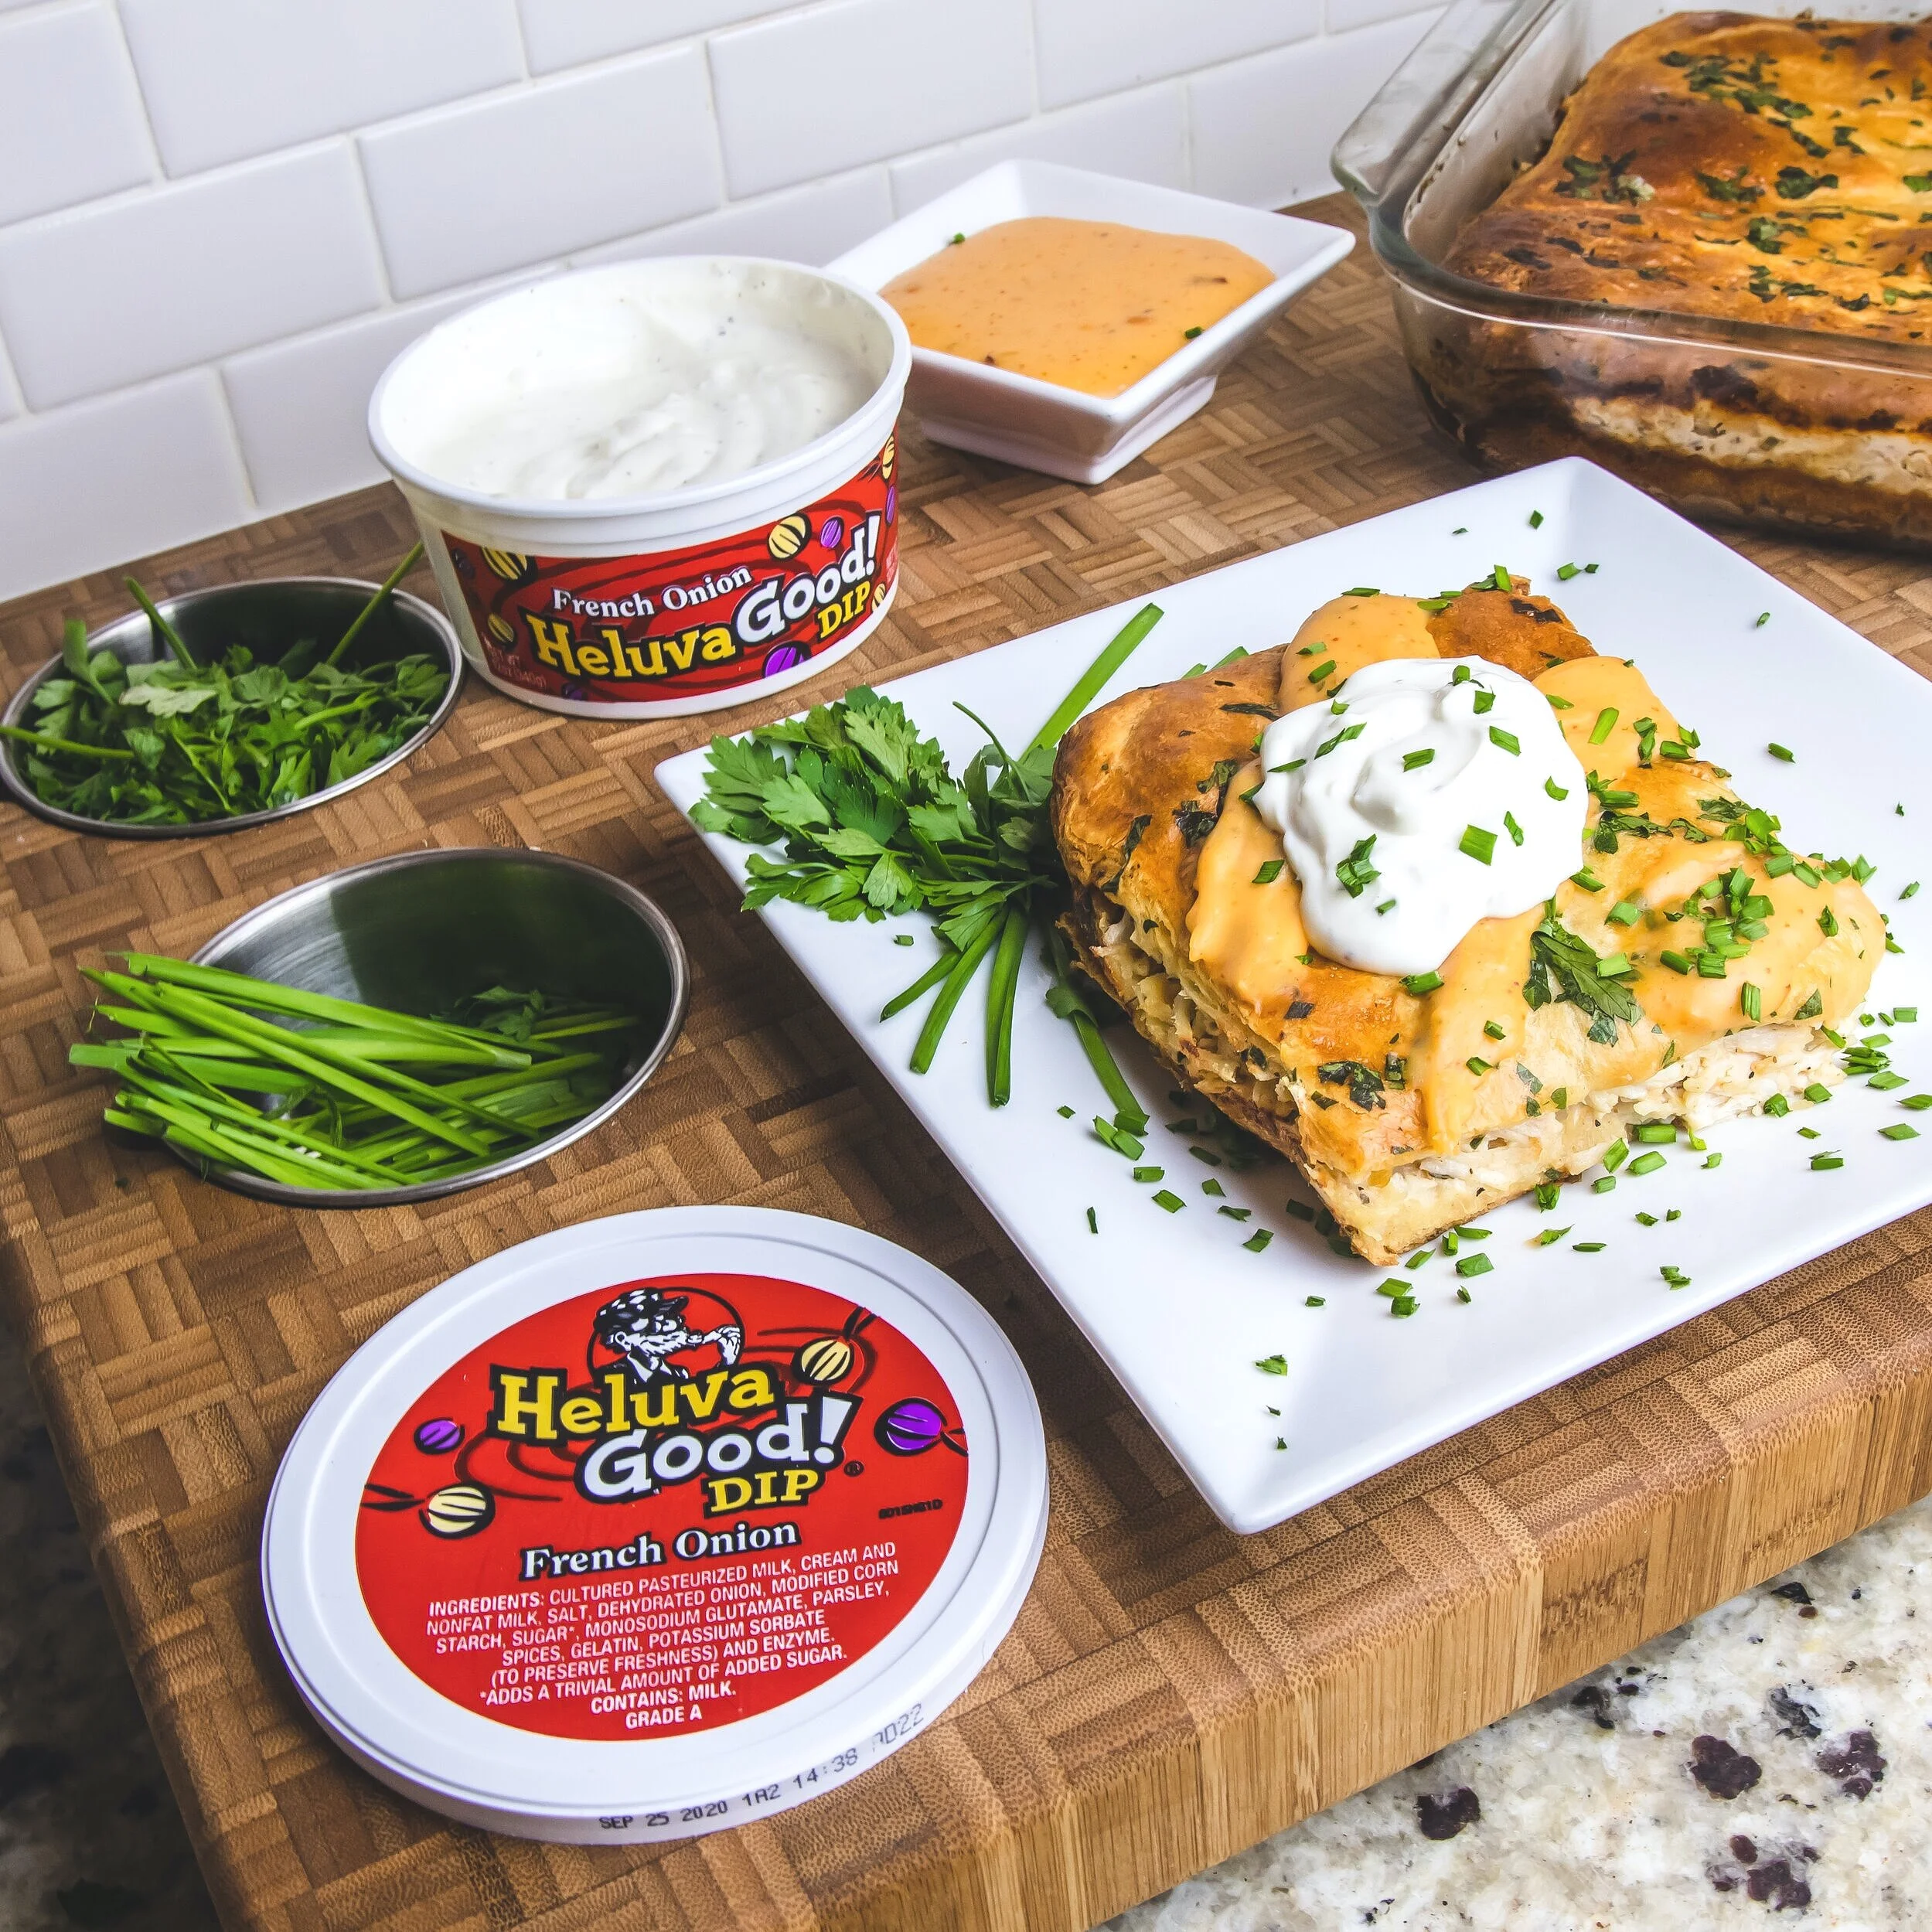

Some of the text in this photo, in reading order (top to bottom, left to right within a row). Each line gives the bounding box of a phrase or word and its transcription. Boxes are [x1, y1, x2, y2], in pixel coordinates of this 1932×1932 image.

[526, 614, 736, 677] Heluva
[736, 515, 881, 642] Good!
[553, 567, 752, 617] French Onion
[818, 581, 871, 638] DIP
[496, 1369, 775, 1440] Heluva
[583, 1396, 852, 1498] Good!
[708, 1468, 819, 1512] DIP
[524, 1521, 798, 1578] French Onion
[426, 1560, 899, 1636] NONFAT MILK, SALT, DEHYDRATED ONION, MODIFIED CORN
[429, 1542, 896, 1617] INGREDIENTS: CULTURED PASTEURIZED MILK, CREAM AND
[436, 1633, 506, 1654] STARCH,
[585, 1609, 700, 1637] MONOSODIUM
[705, 1595, 808, 1624] GLUTAMATE,
[813, 1580, 889, 1607] PARSLEY,
[502, 1610, 825, 1667] SPICES, GELATIN, POTASSIUM SORBATE
[491, 1627, 834, 1688] (TO PRESERVE FRESHNESS) AND ENZYME.
[537, 1686, 550, 1700] A
[555, 1678, 616, 1699] TRIVIAL
[621, 1667, 693, 1690] AMOUNT
[698, 1663, 720, 1679] OF
[724, 1654, 782, 1677] ADDED
[787, 1644, 847, 1668] SUGAR.
[591, 1681, 736, 1715] CONTAINS: MILK.
[625, 1704, 702, 1729] GRADE A
[598, 1815, 633, 1830] SEP
[645, 1812, 670, 1826] 25
[682, 1800, 729, 1823] 2020
[792, 1748, 858, 1790] 14:38
